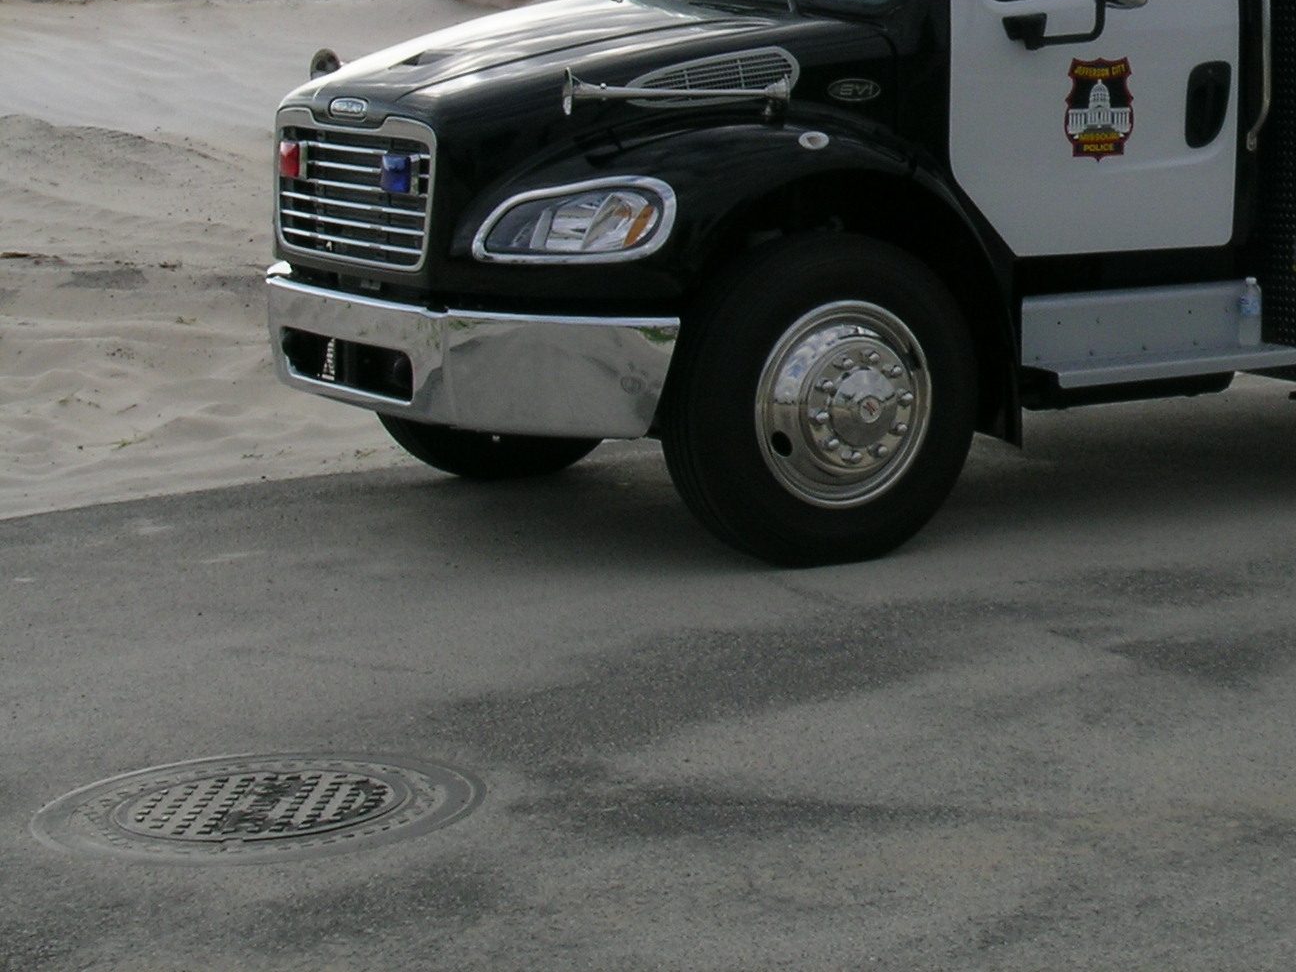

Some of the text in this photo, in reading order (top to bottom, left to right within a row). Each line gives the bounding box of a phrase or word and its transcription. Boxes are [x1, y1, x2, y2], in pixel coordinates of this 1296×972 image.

[1074, 64, 1126, 77] JEFFERSON CITY
[1083, 144, 1114, 152] POLICE
